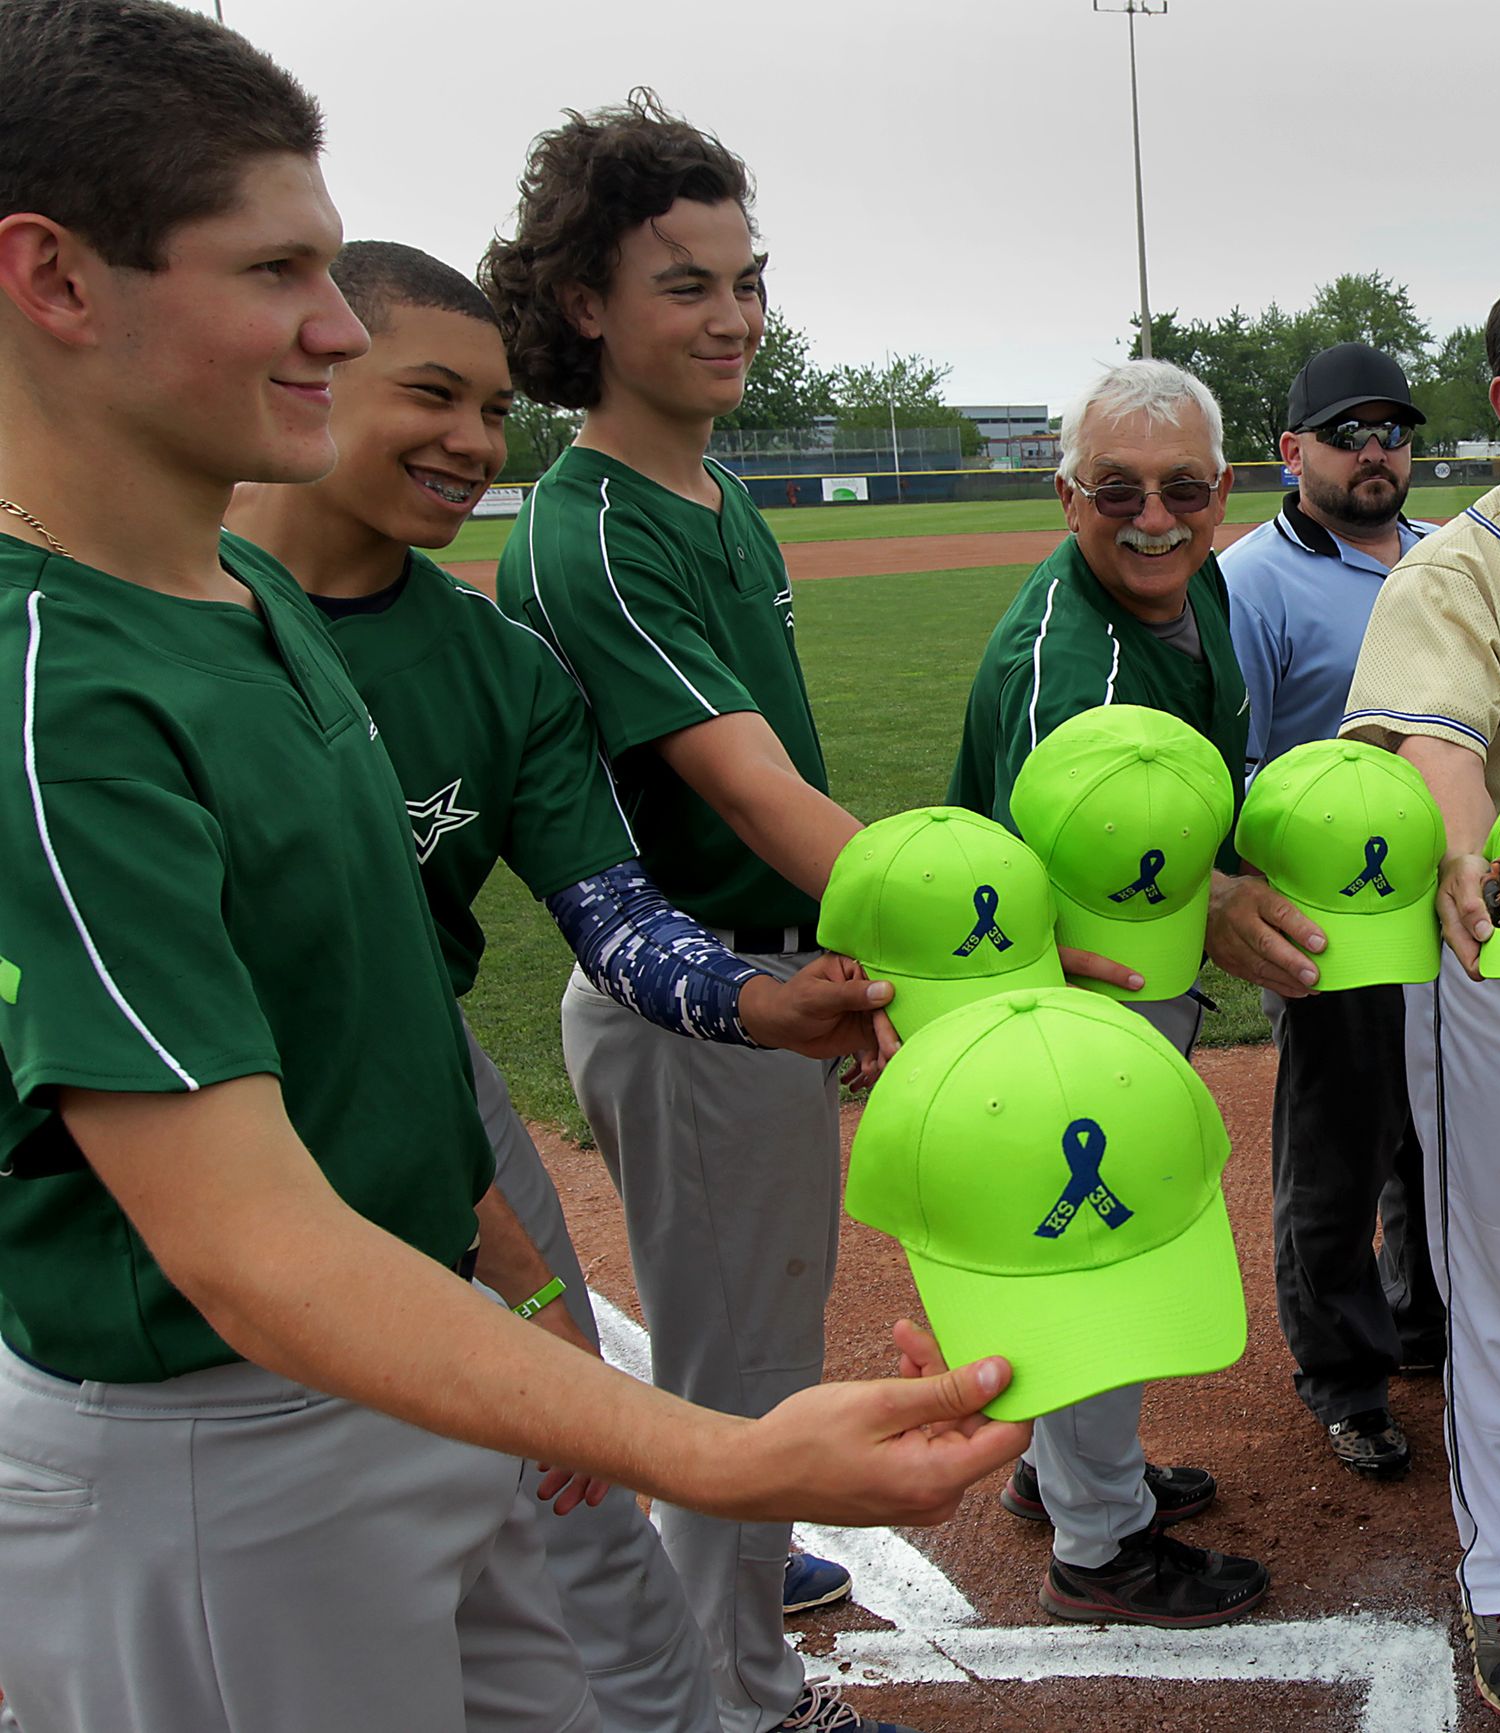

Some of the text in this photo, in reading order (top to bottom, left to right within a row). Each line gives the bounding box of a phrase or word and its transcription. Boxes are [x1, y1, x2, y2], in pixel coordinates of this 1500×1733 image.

[1373, 873, 1387, 890] 35
[988, 926, 1004, 945] 35
[1089, 1185, 1116, 1216] 35
[1045, 1200, 1075, 1231] KS
